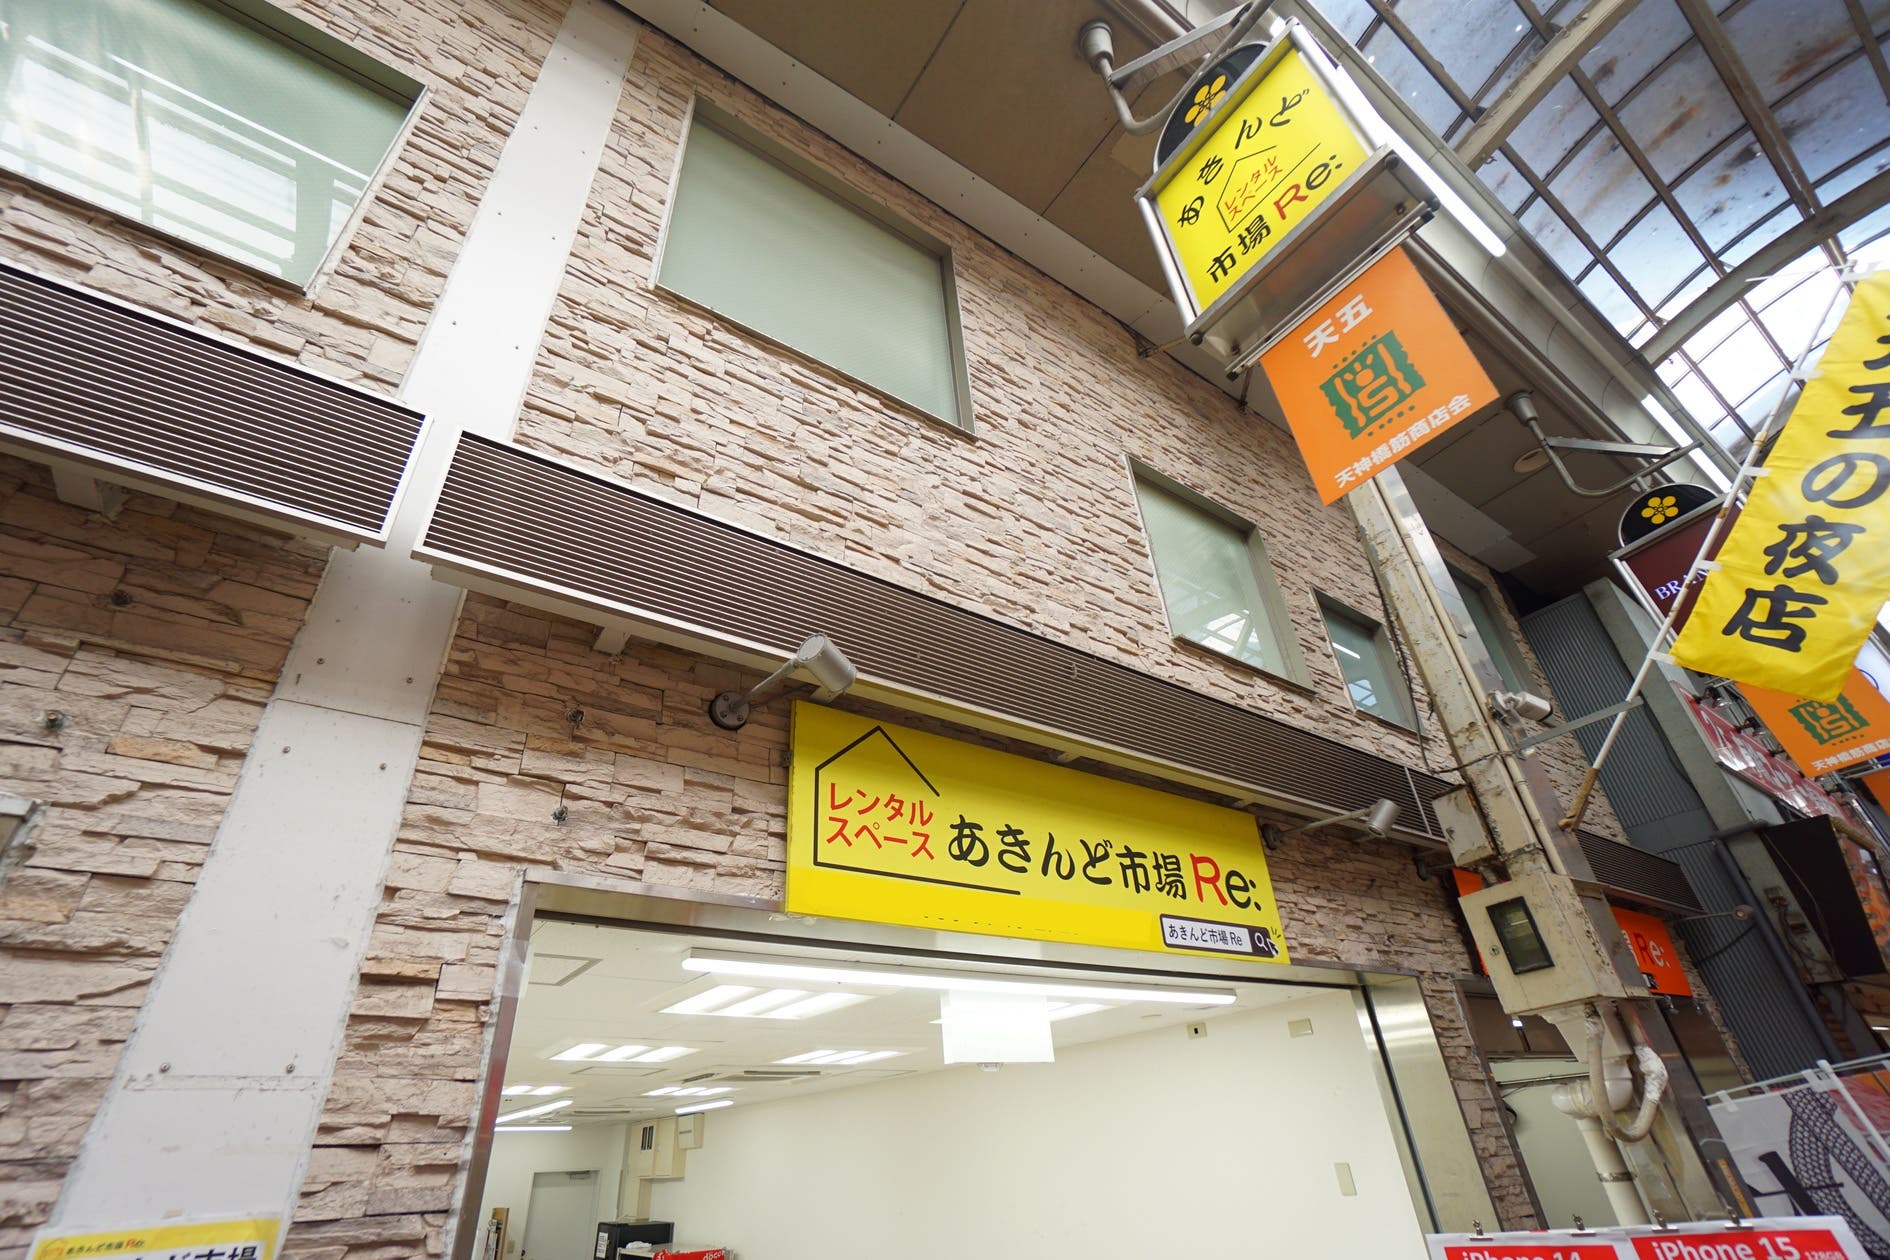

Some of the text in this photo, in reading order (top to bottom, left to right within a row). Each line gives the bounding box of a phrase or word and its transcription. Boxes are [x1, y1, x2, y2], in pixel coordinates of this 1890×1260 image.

[1177, 88, 1310, 228] あきんど
[1224, 155, 1277, 211] レンタル
[1229, 165, 1284, 222] スペース
[1303, 293, 1374, 359] 天五
[1722, 310, 1890, 652] 五の夜店
[830, 782, 934, 828] レンタル
[826, 816, 935, 861] スペース
[1652, 1240, 1754, 1260] iPhone
[1758, 1236, 1801, 1260] 15
